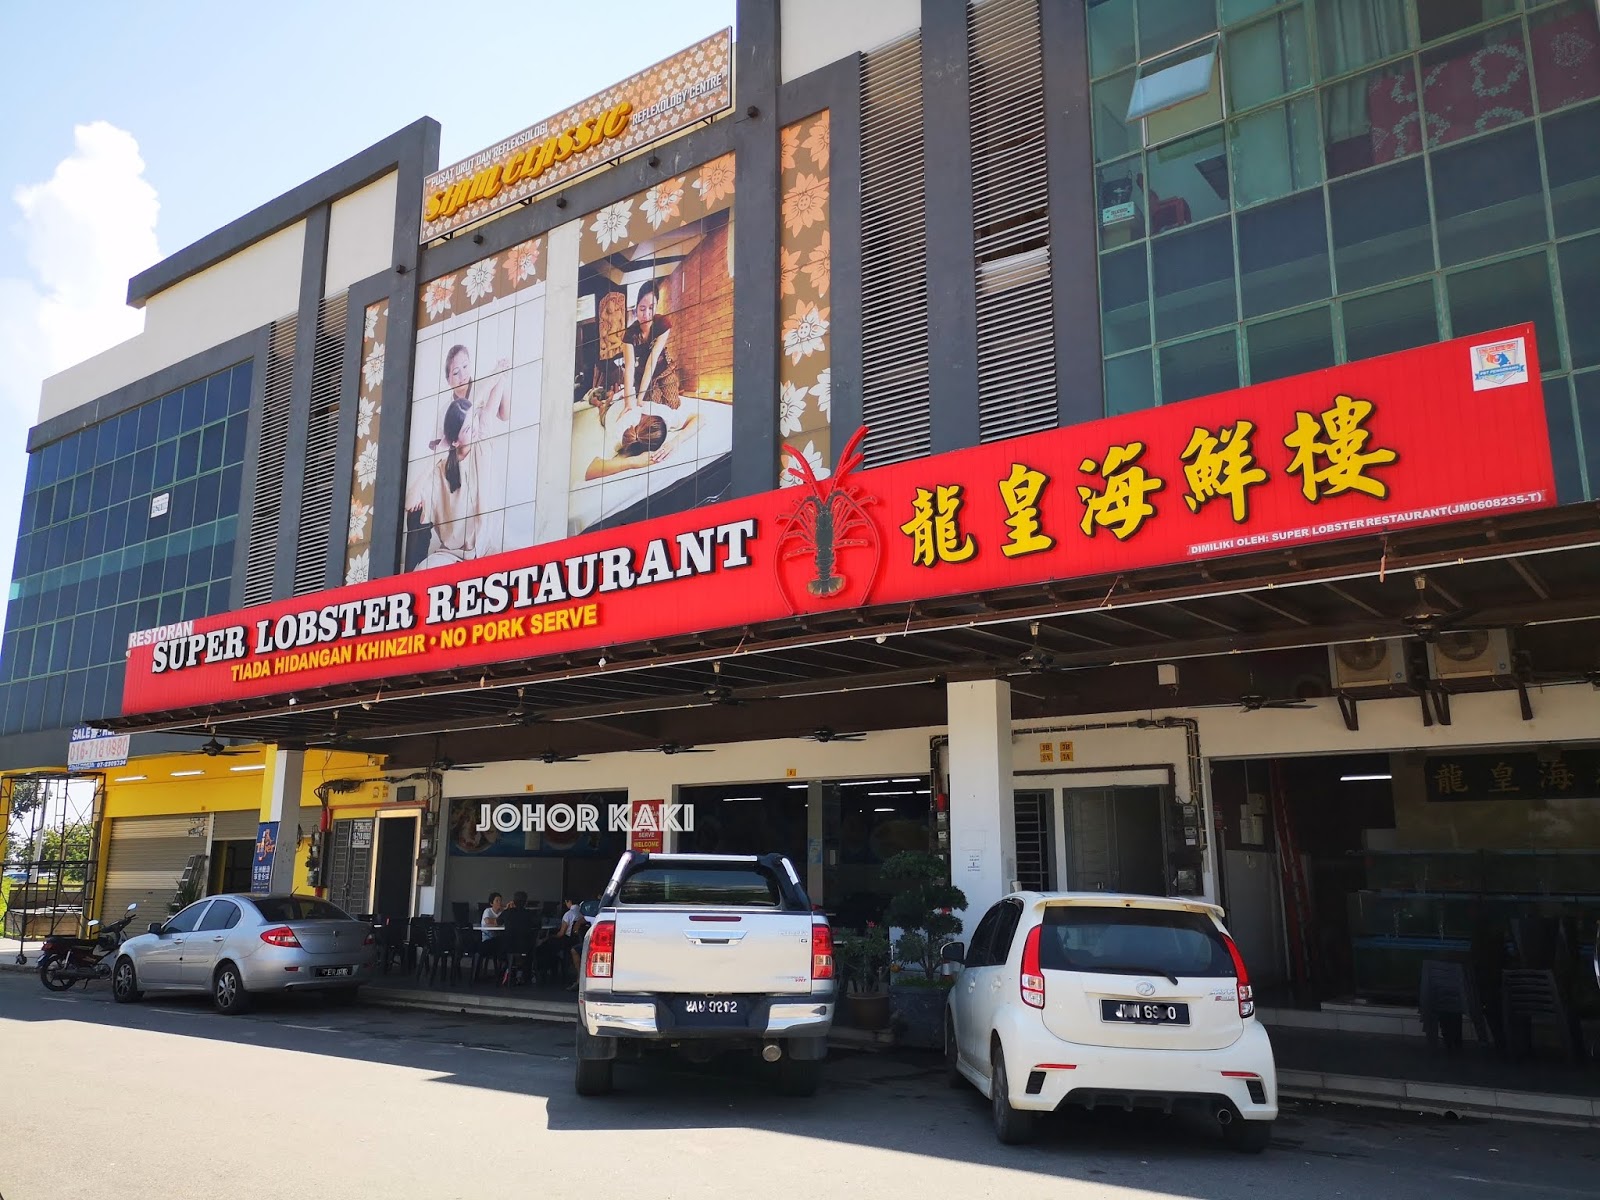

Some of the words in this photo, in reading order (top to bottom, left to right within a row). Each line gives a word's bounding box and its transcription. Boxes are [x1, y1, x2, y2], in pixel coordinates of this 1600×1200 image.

[632, 89, 689, 126] REFLEXOLOGY
[689, 73, 723, 99] CENTRE
[431, 171, 455, 187] PUSAT
[455, 159, 474, 176] URUT
[476, 151, 492, 167] DAN
[493, 122, 549, 158] REFLEKSOLOGI
[502, 100, 633, 186] CLASSIC
[900, 394, 1399, 568] 龍皇海鮮樓
[1191, 540, 1234, 554] DIMILIKI
[1236, 535, 1269, 547] OLEH:
[1271, 528, 1310, 542] SUPER
[1312, 520, 1365, 535] LOBSTER
[151, 626, 247, 674] SUPER
[254, 591, 416, 654] LOBSTER
[425, 518, 757, 625] RESTAURANT
[128, 621, 194, 647] RESTORAN
[230, 660, 271, 683] TIADA
[274, 645, 352, 676] HIDANGAN
[355, 633, 426, 662] KHINZIR
[440, 627, 467, 650] NO
[472, 616, 526, 645] PORK
[530, 604, 598, 635] SERVE
[72, 727, 91, 740] SALE
[1434, 759, 1600, 795] 龍皇海
